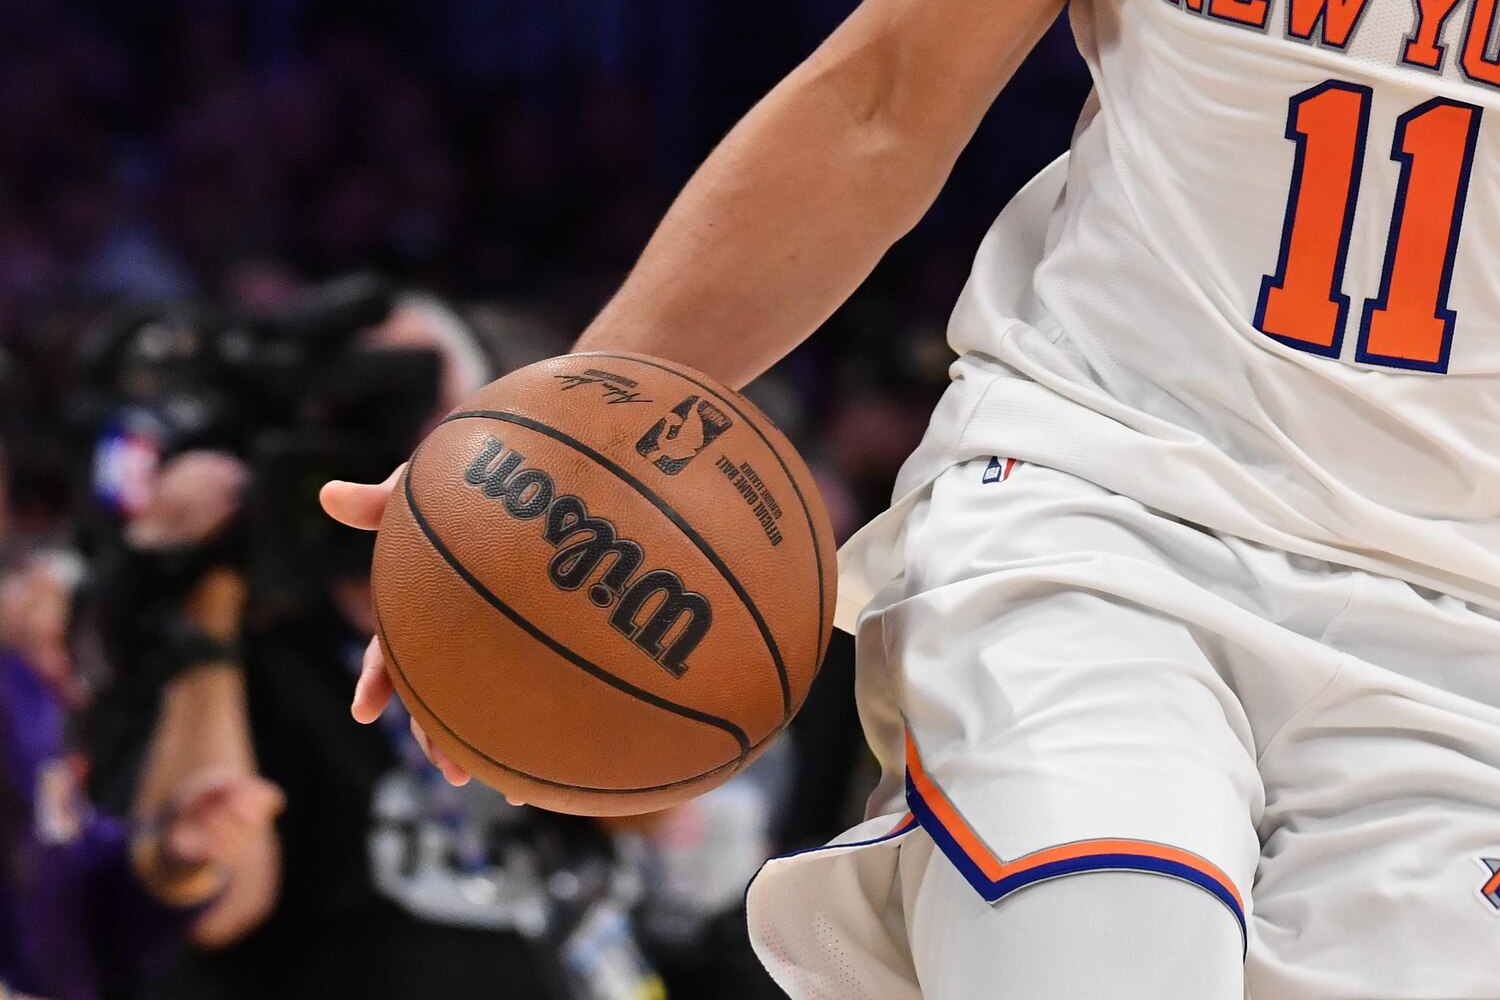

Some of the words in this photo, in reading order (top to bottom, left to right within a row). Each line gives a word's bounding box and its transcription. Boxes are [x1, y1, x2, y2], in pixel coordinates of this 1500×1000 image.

[1252, 79, 1484, 374] 11
[715, 455, 740, 480] BALL
[740, 462, 765, 492] LEATHER
[733, 476, 759, 506] GAME
[753, 501, 783, 547] OFFICIAL
[464, 436, 713, 680] Wilson
